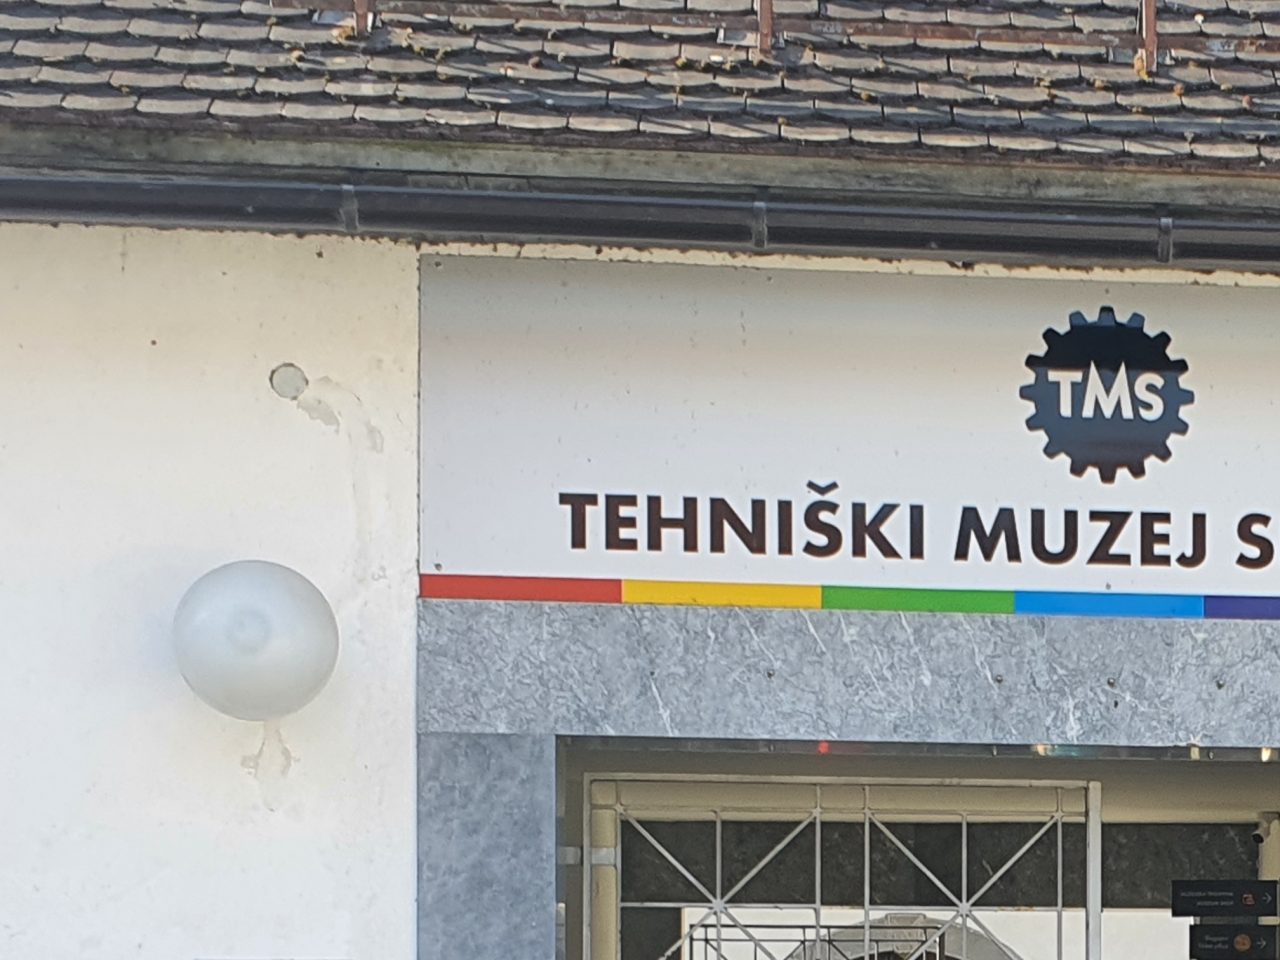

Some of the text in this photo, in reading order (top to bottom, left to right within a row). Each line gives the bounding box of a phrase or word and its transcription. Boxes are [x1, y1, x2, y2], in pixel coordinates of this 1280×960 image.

[1048, 361, 1164, 421] TMS
[558, 481, 926, 561] TEHNIŠKI
[954, 505, 1208, 569] MUZEJ
